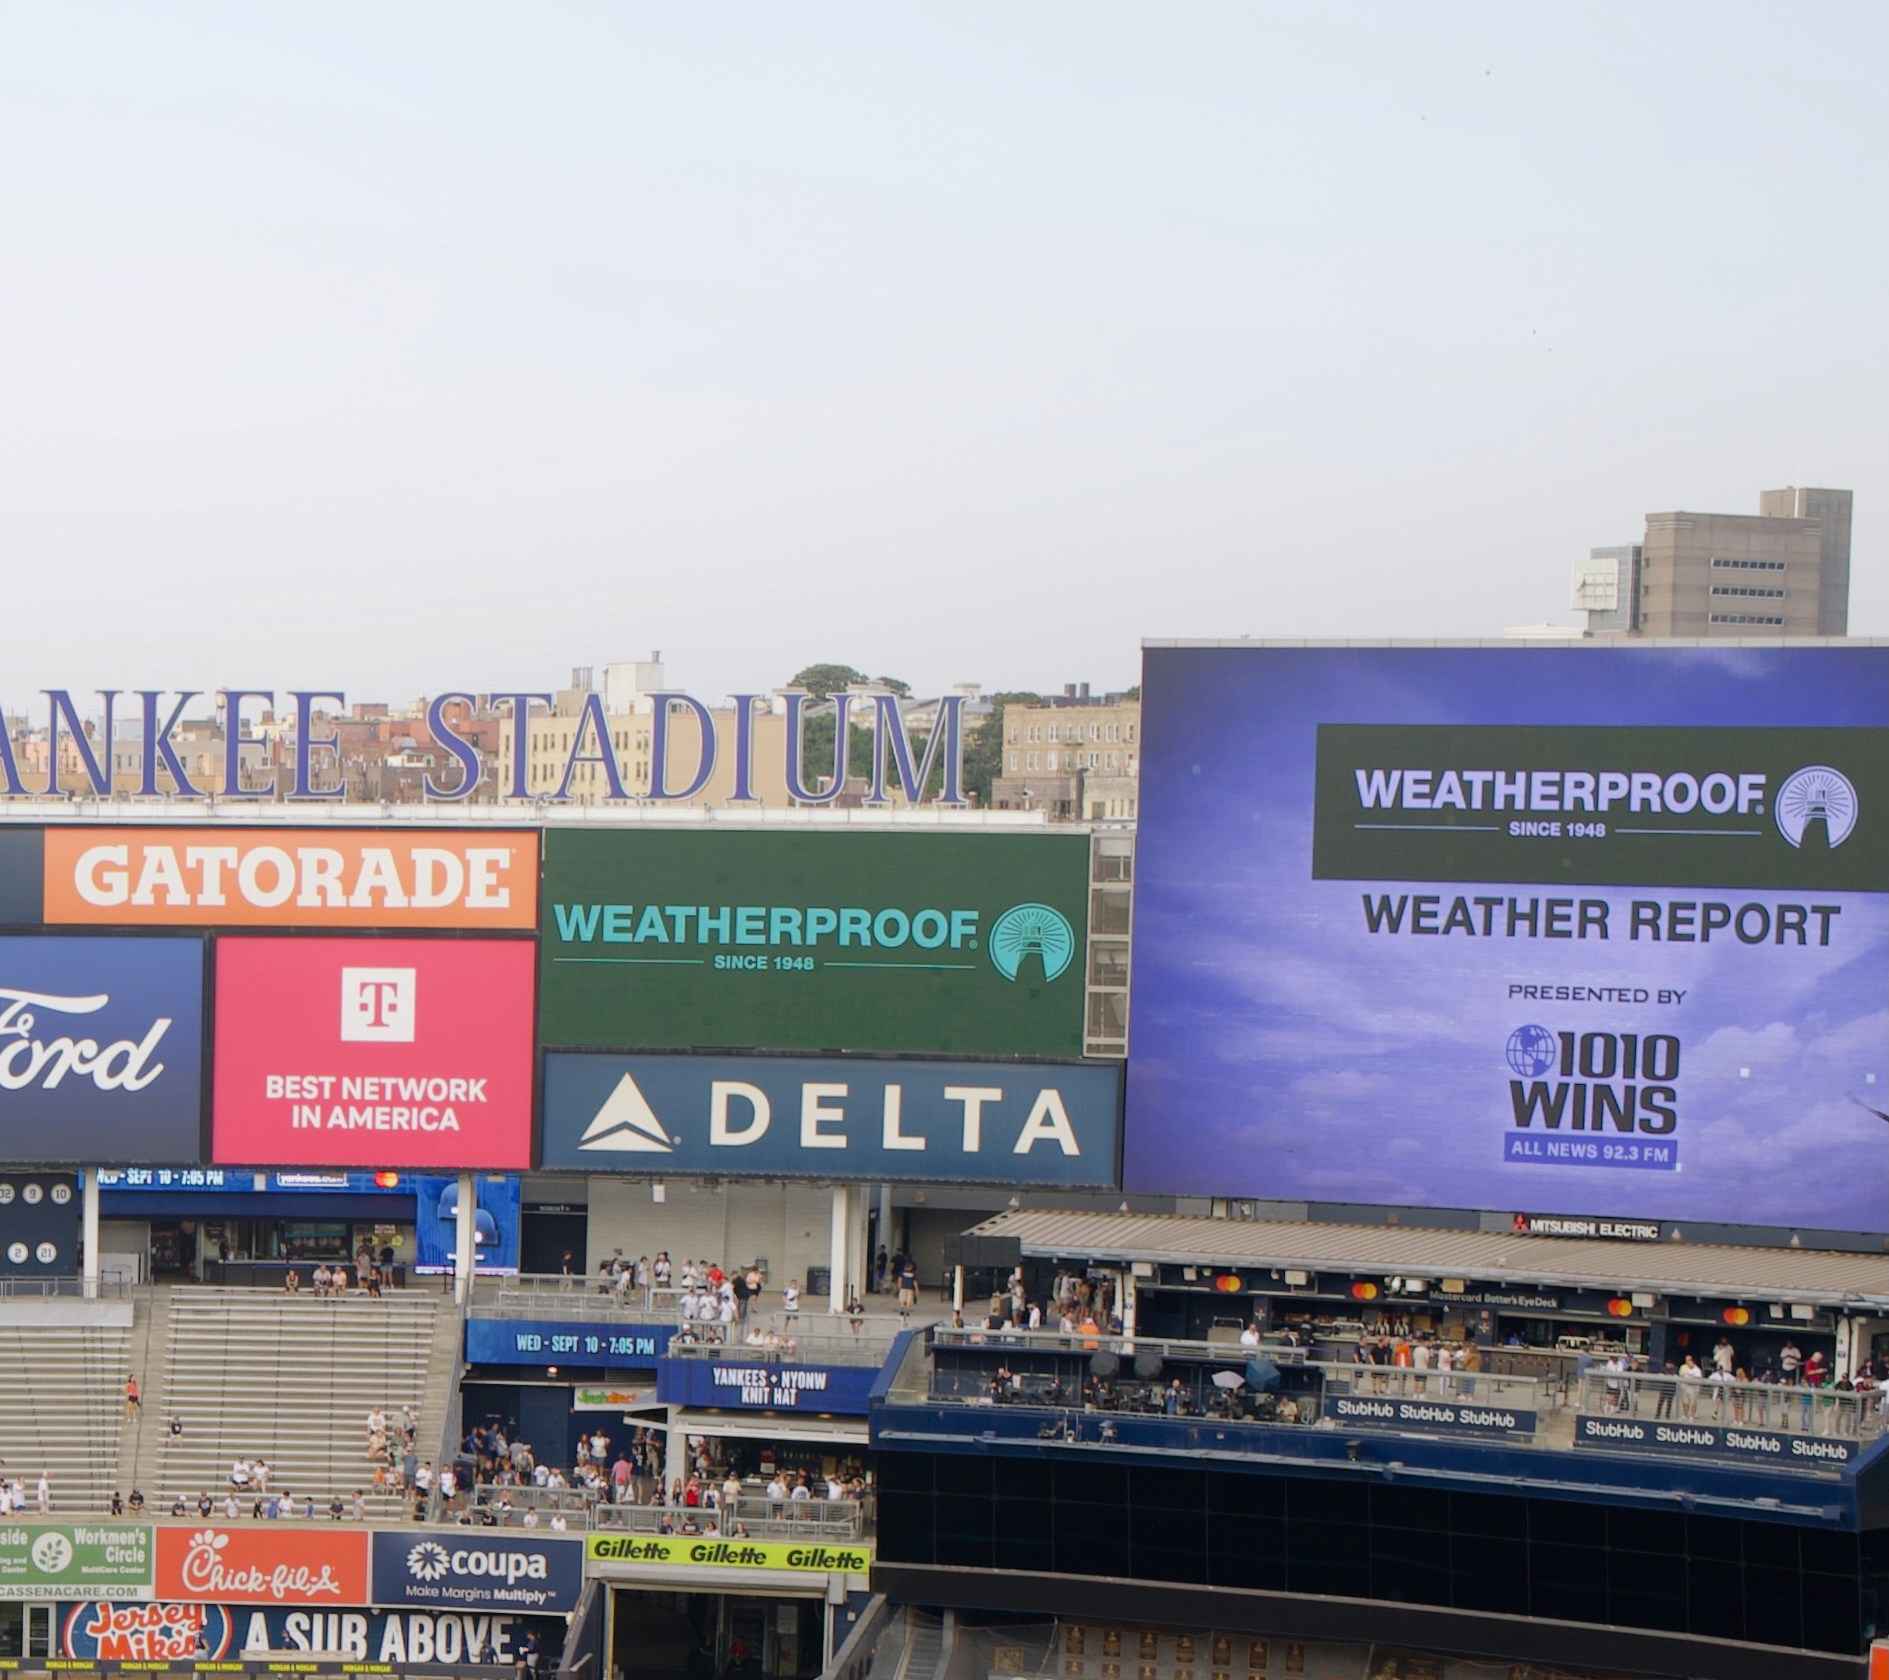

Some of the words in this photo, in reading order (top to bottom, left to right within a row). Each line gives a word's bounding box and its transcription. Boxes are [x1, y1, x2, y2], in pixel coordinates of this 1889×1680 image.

[424, 692, 971, 808] STADIUM
[1508, 821, 1561, 836] SINCE
[1566, 822, 1606, 838] 1948
[74, 846, 510, 909] GATORADE
[1362, 894, 1610, 940] WEATHER
[1630, 900, 1840, 946] REPORT
[714, 954, 767, 969] SINCE
[774, 956, 814, 971] 1948
[357, 981, 398, 1028] T
[1508, 985, 1648, 1002] PRESENTED
[1656, 989, 1687, 1004] BY
[1558, 1031, 1680, 1081] 1010
[266, 1075, 335, 1099] BEST
[341, 1077, 486, 1102] NETWORK
[292, 1104, 321, 1128] IN
[326, 1106, 460, 1132] AMERICA
[1509, 1081, 1678, 1134] WINS
[709, 1081, 1080, 1157] DELTA
[1512, 1141, 1542, 1156] ALL
[1547, 1142, 1598, 1159] NEWS
[1603, 1144, 1638, 1160] 92.3
[1643, 1146, 1669, 1161] FM
[1530, 1219, 1596, 1236] MITSUBISHI
[1600, 1222, 1658, 1238] ELECTRIC
[1337, 1400, 1394, 1417] StubHub
[1586, 1422, 1643, 1439] StubHub
[1726, 1432, 1780, 1453] StubHub
[1792, 1440, 1847, 1459] StubHub
[74, 1527, 146, 1546] Workmen's
[106, 1546, 144, 1563] Circle
[594, 1539, 670, 1560] Gillette
[690, 1544, 766, 1564] Gillette
[787, 1549, 863, 1570] Gillette
[452, 1548, 546, 1583] coupa
[406, 1585, 439, 1598] Make
[442, 1587, 490, 1602] Margins
[493, 1588, 548, 1605] Multiply
[86, 1602, 206, 1633] Jersey
